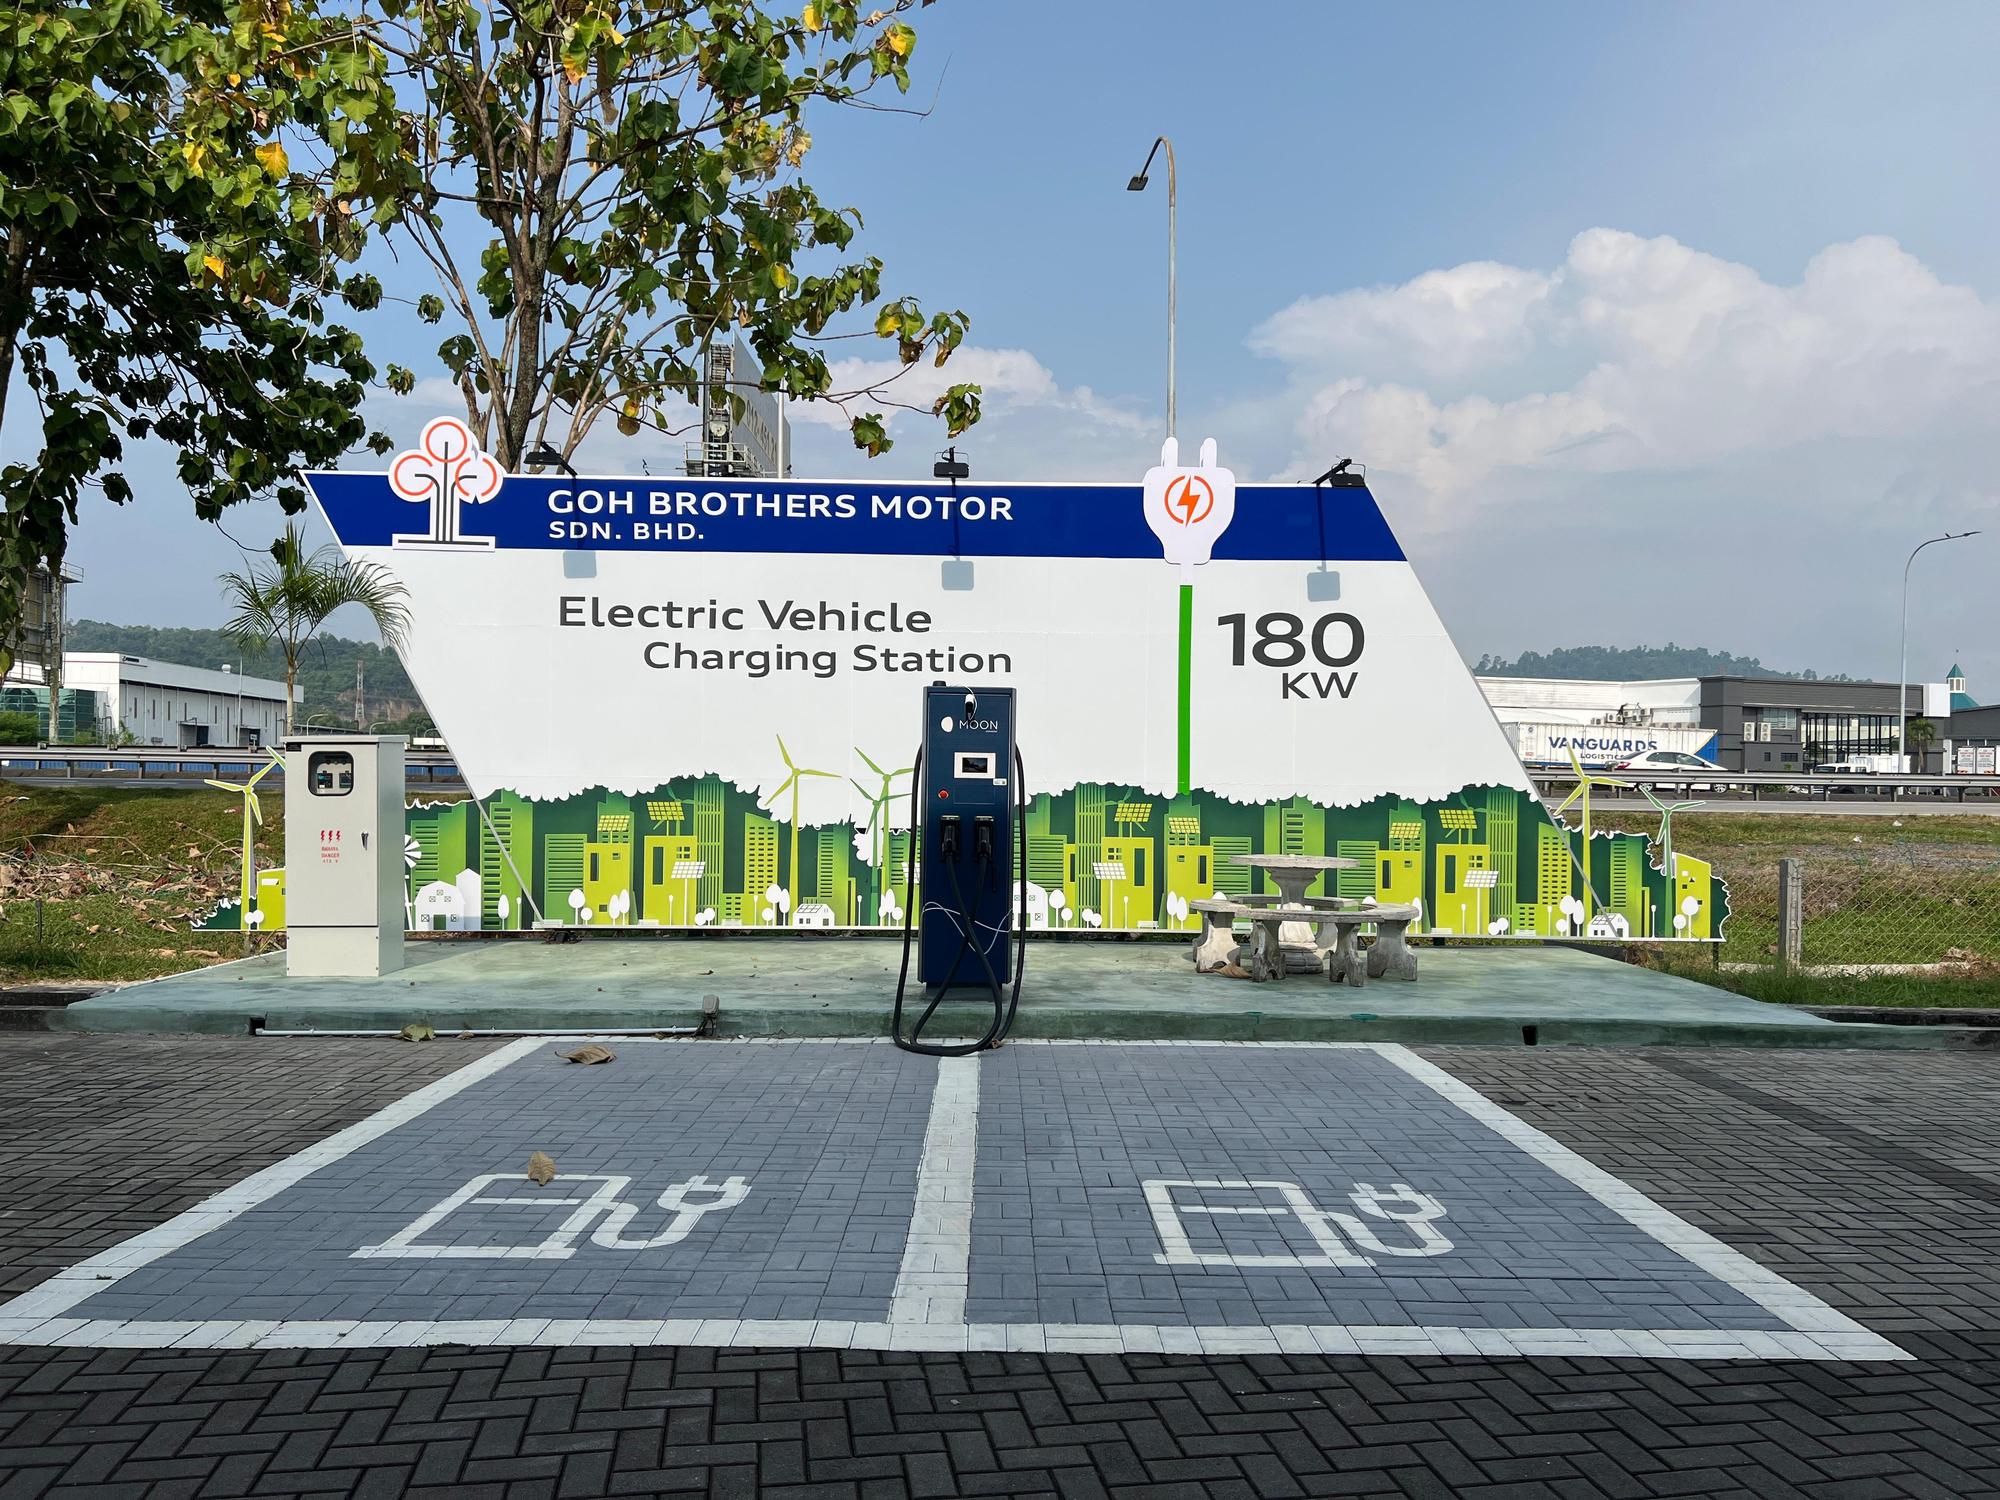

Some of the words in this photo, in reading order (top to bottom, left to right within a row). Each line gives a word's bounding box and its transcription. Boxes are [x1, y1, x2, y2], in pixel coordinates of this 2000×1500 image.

[548, 489, 633, 514] GOH
[649, 491, 856, 518] BROTHERS
[871, 495, 1013, 521] MOTOR
[549, 520, 621, 540] SDN.
[633, 522, 704, 540] BHD.
[559, 596, 744, 631] Electric
[757, 599, 932, 633] Vehicle
[1217, 612, 1365, 668] 180
[643, 641, 837, 679] Charging
[853, 644, 1012, 673] Station
[1282, 671, 1359, 700] KW
[959, 719, 998, 730] MOON
[1548, 736, 1658, 752] VANGUARDS
